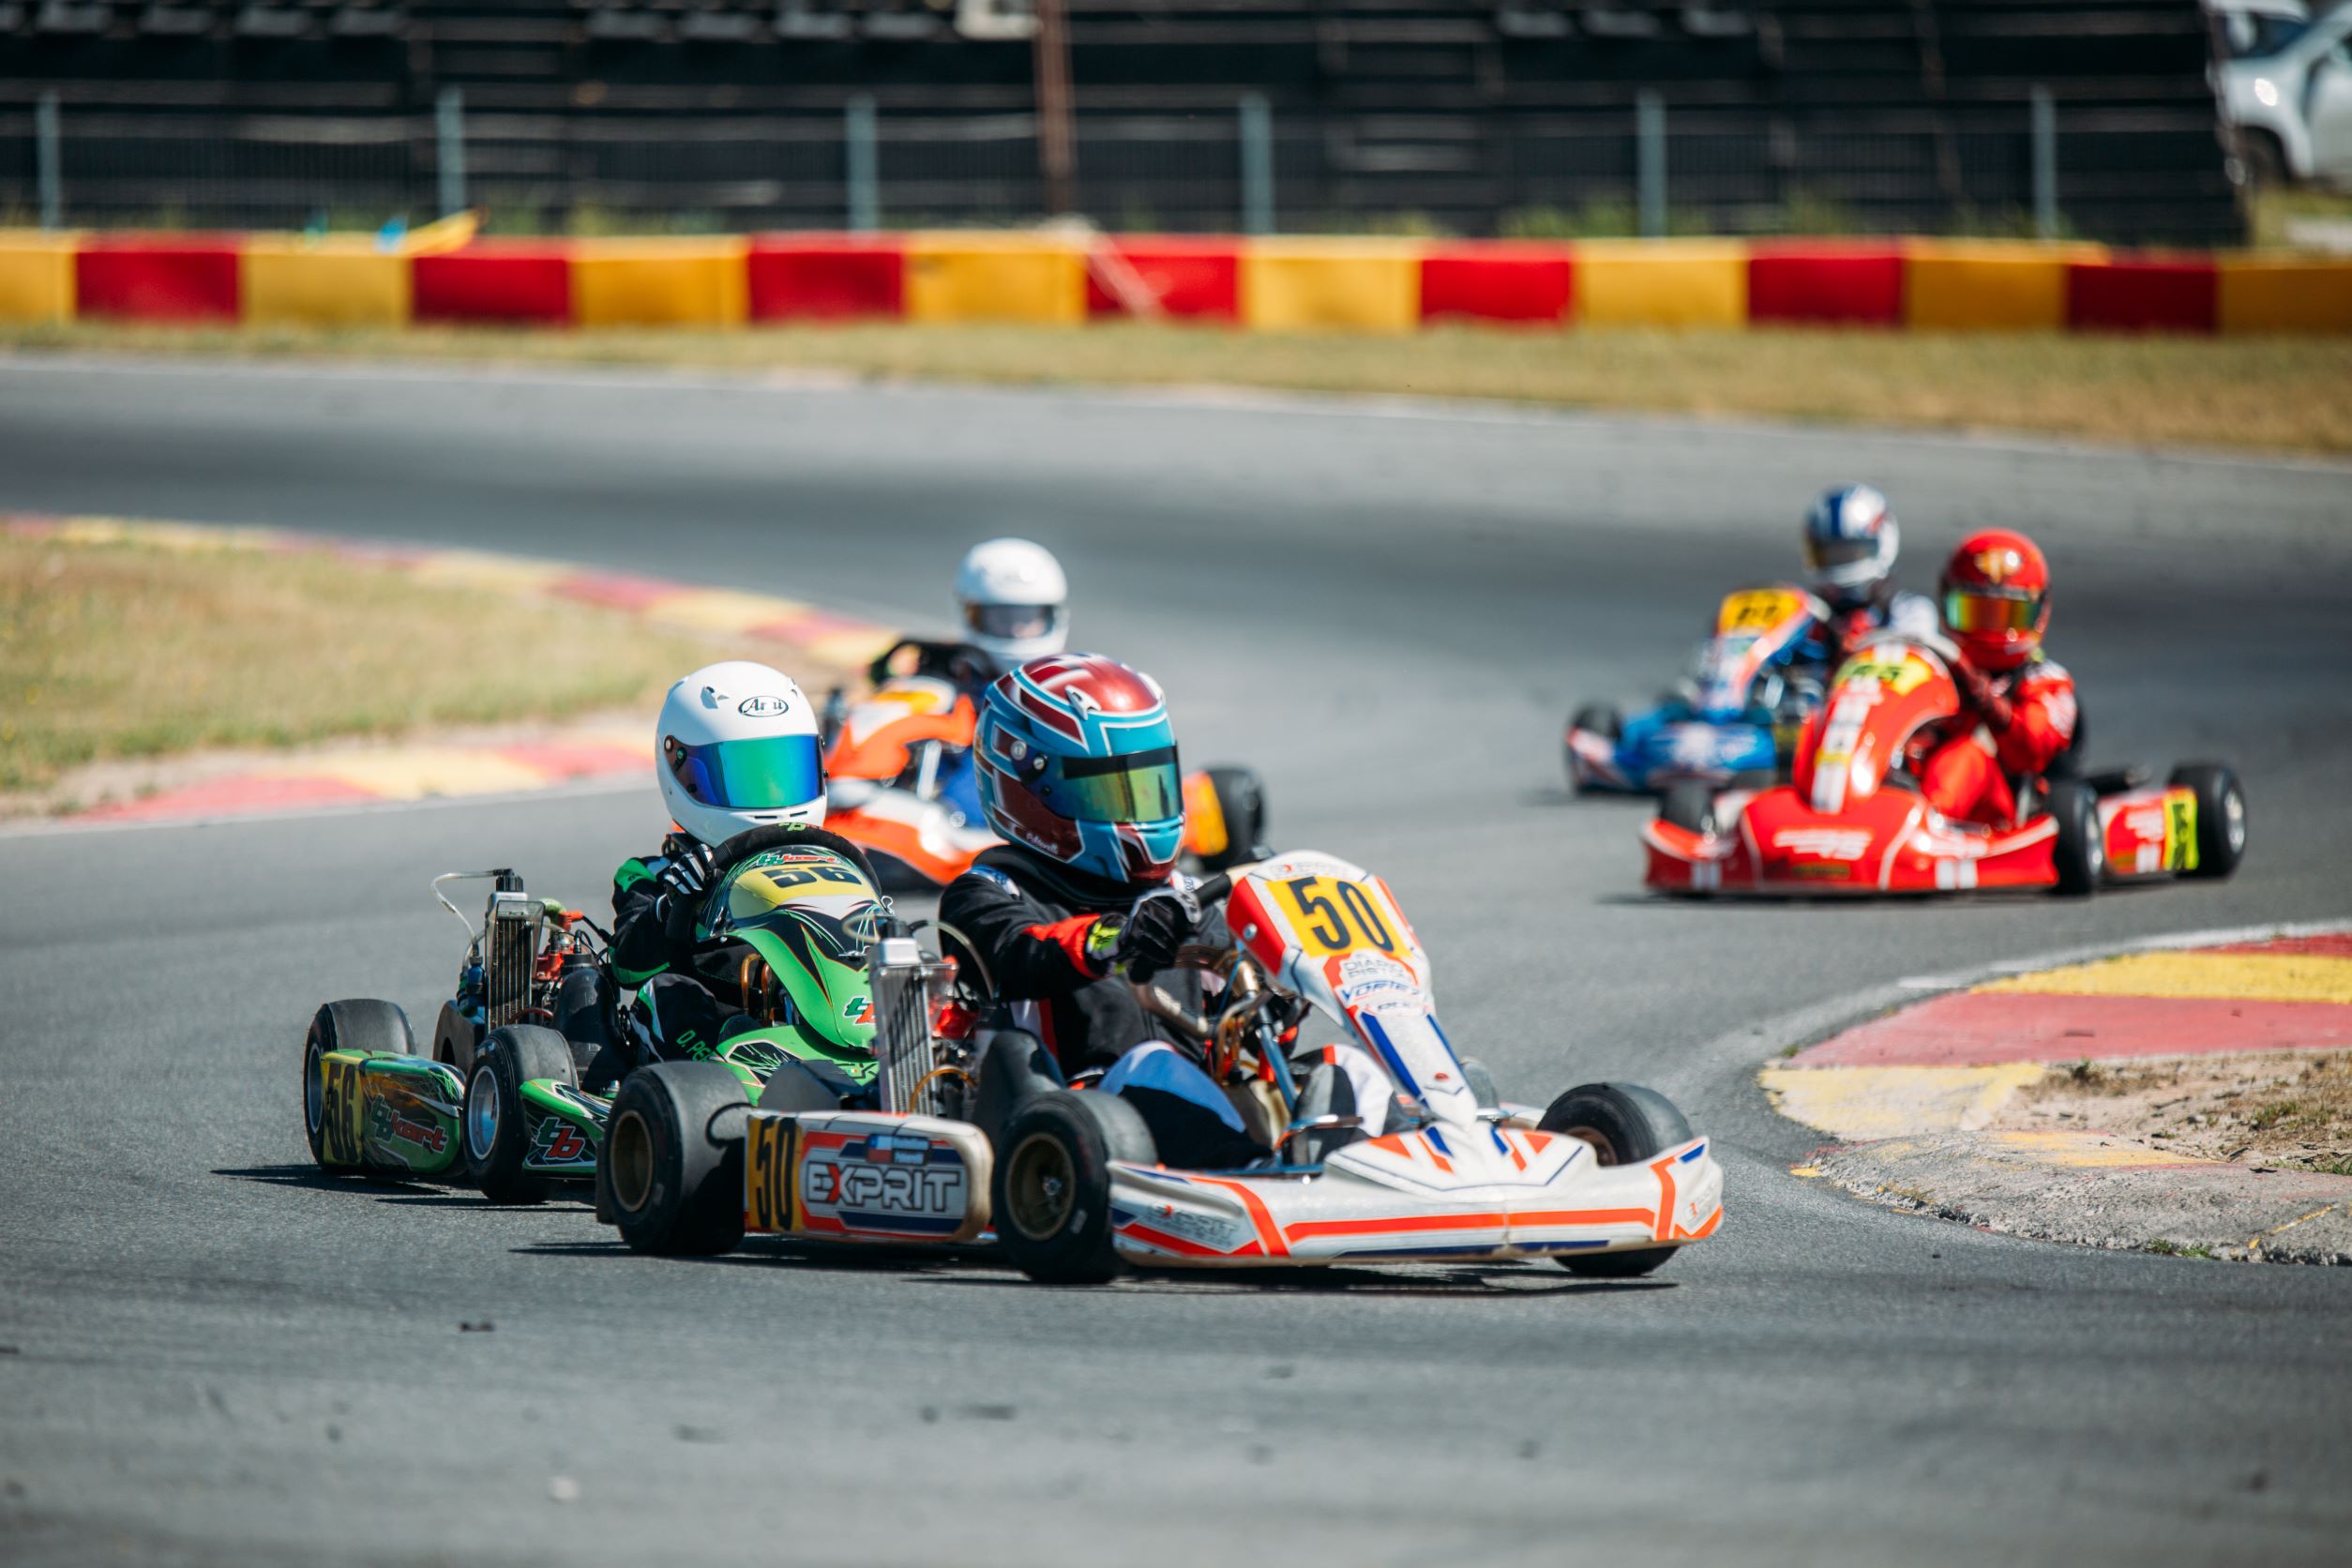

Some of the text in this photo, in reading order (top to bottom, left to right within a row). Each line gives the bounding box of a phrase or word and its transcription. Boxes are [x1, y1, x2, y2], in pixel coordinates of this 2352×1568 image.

[761, 867, 863, 889] 56
[1288, 876, 1395, 951] 50
[676, 1030, 696, 1048] D.
[328, 1056, 358, 1160] 56
[756, 1116, 797, 1230] 50
[807, 1161, 961, 1213] EXPRIT
